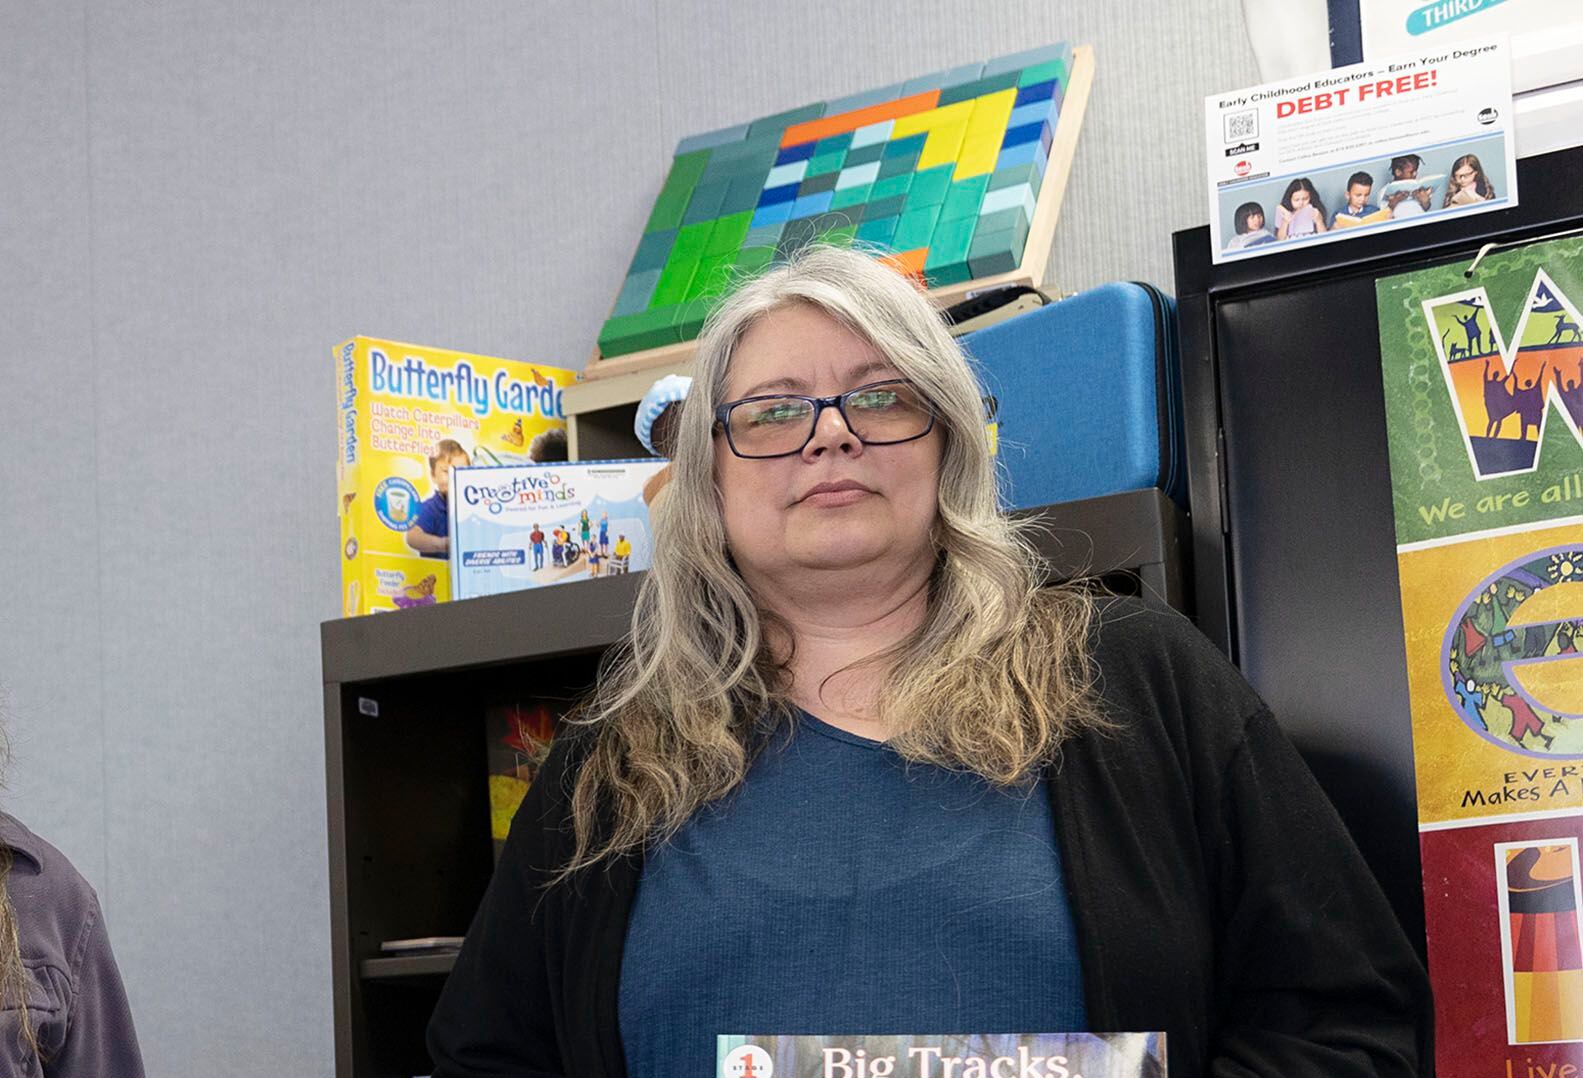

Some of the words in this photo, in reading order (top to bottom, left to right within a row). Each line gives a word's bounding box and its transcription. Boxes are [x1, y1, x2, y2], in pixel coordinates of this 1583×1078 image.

[1219, 97, 1247, 109] Early
[1251, 83, 1311, 102] Childhood
[1314, 70, 1374, 88] Educators
[1388, 61, 1416, 72] Earn
[1420, 54, 1449, 66] Your
[1453, 44, 1498, 59] Degree
[1276, 88, 1350, 119] DEBT
[1358, 69, 1438, 102] FREE!
[371, 351, 489, 415] Butterfly
[371, 402, 410, 421] Watch
[413, 408, 479, 431] Caterpillars
[371, 419, 414, 439] Change
[519, 482, 575, 504] minds
[1418, 497, 1465, 525] We
[1476, 490, 1530, 513] are
[1541, 474, 1582, 504] all
[1504, 764, 1583, 784] EVER
[1460, 785, 1540, 808] Makes
[1549, 778, 1569, 798] A
